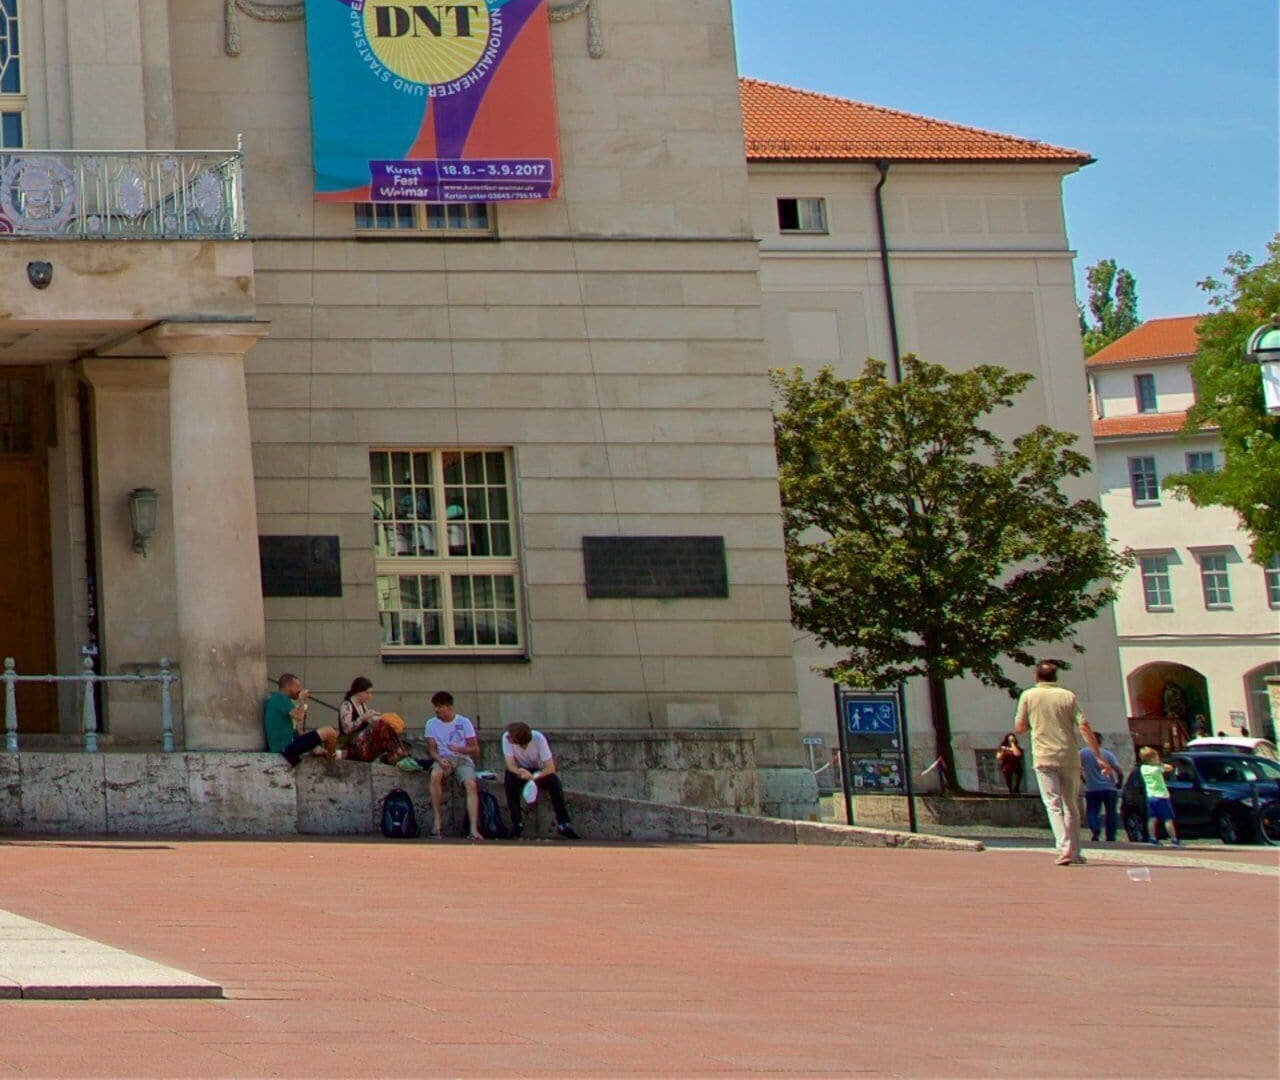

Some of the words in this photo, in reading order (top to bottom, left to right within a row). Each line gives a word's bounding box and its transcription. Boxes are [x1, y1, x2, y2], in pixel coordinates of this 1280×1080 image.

[372, 5, 480, 38] DNT
[428, 7, 502, 97] NATIONALTHEATER
[392, 78, 424, 96] UND
[385, 165, 423, 175] Kunst
[393, 175, 419, 186] Fest
[380, 187, 429, 197] Weimar
